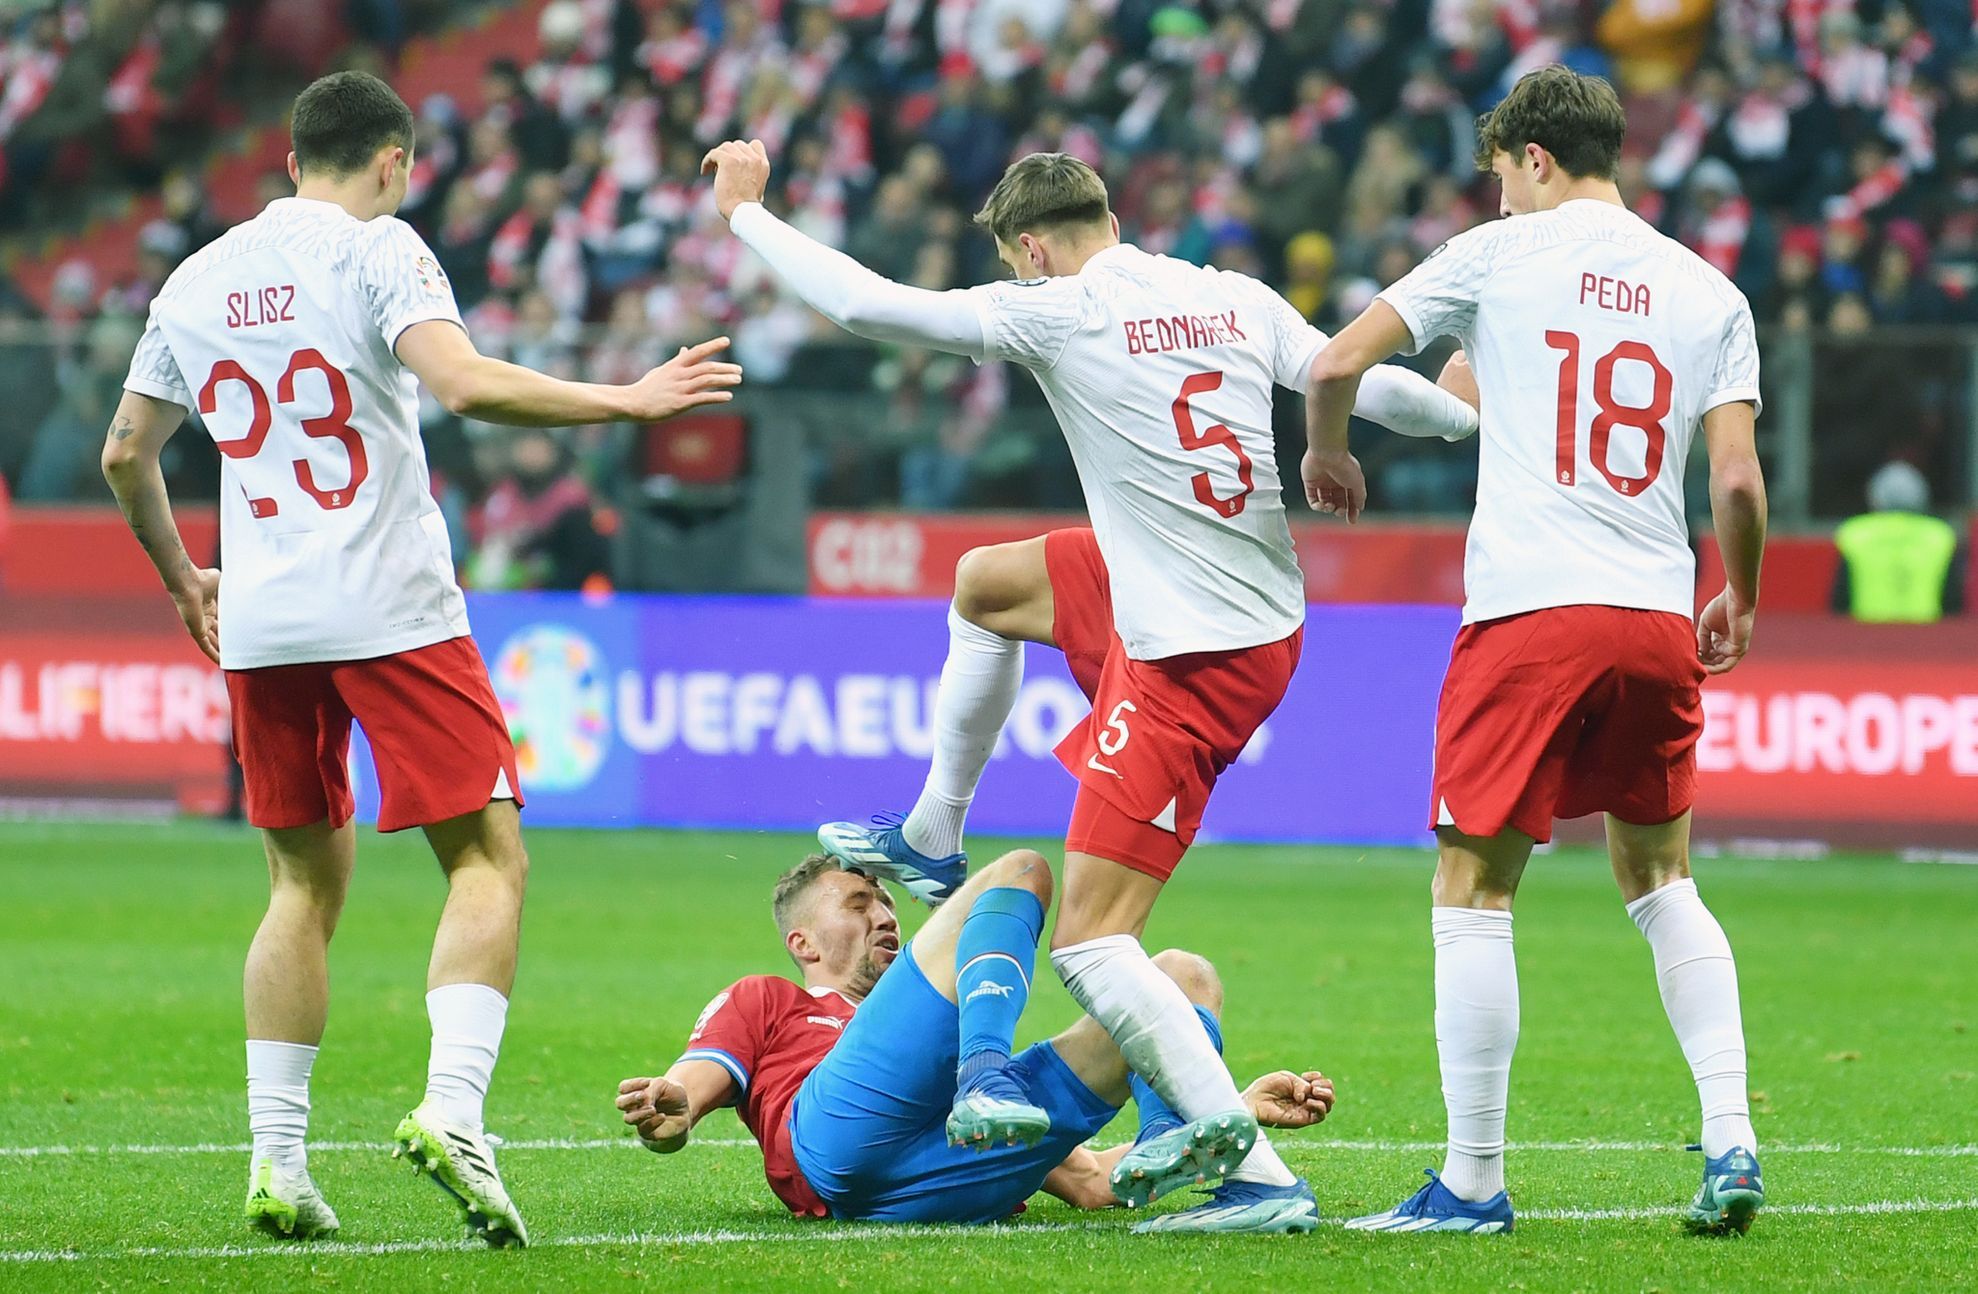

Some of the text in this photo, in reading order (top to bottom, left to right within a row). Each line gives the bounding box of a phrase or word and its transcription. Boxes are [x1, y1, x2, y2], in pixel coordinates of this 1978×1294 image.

[226, 285, 296, 328] SLISZ
[1579, 272, 1651, 317] PEDA
[1124, 310, 1247, 355] BEDNAREK
[198, 347, 369, 519] 23
[1545, 330, 1673, 498] 18
[1171, 370, 1255, 519] 5
[1098, 698, 1137, 756] 5
